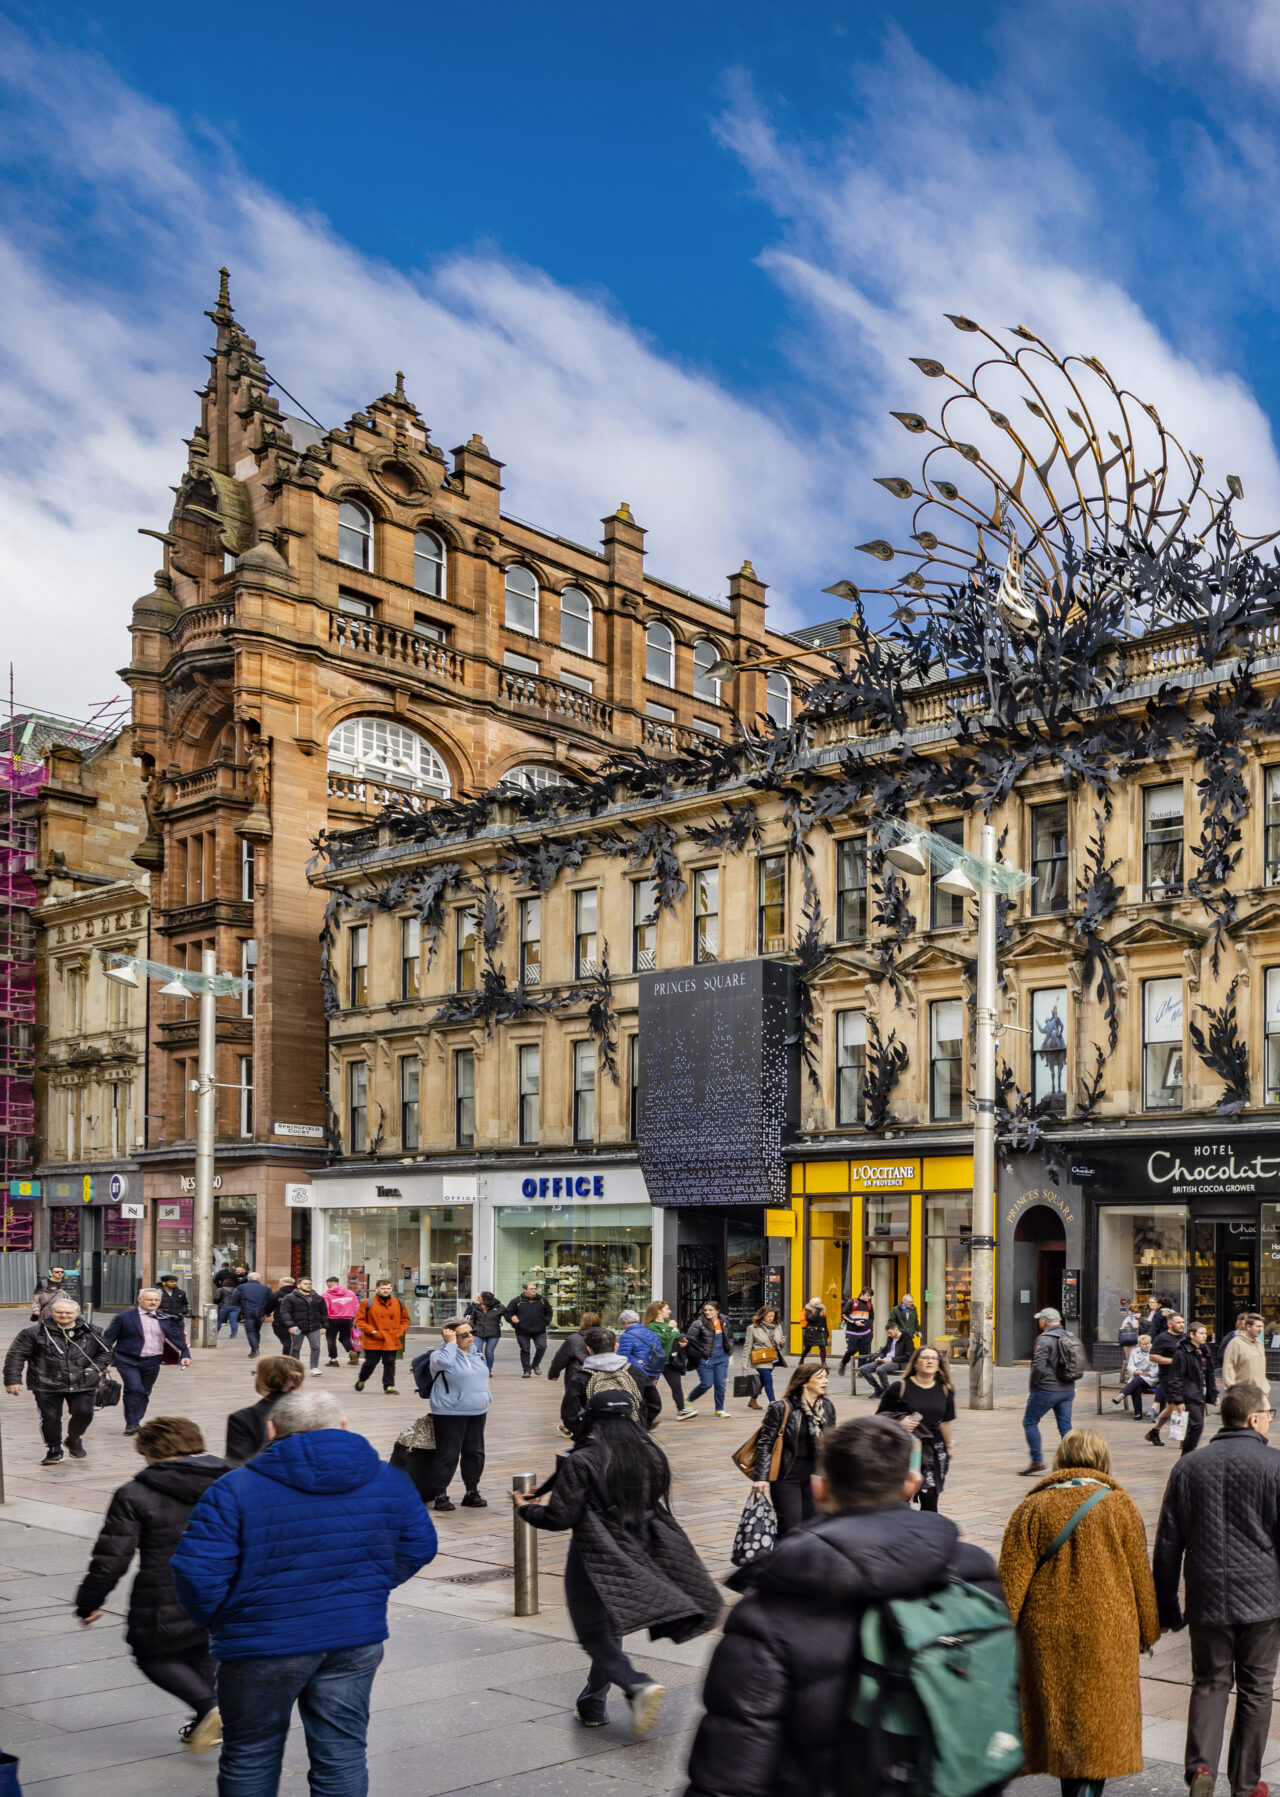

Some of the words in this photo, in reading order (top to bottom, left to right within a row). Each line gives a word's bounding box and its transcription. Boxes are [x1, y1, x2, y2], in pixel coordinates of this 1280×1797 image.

[654, 978, 696, 996] PRINCES
[703, 972, 747, 992] SQUARE
[1194, 1145, 1234, 1156] HOTEL
[112, 1183, 119, 1193] BT
[521, 1175, 605, 1198] OFFICE
[873, 1179, 904, 1187] PROVENCE
[1172, 1185, 1197, 1193] BRITISH
[1198, 1185, 1224, 1193] COCOA
[1225, 1184, 1256, 1192] GROWER
[1006, 1189, 1040, 1224] PRINCES
[1042, 1189, 1075, 1224] SQUARE
